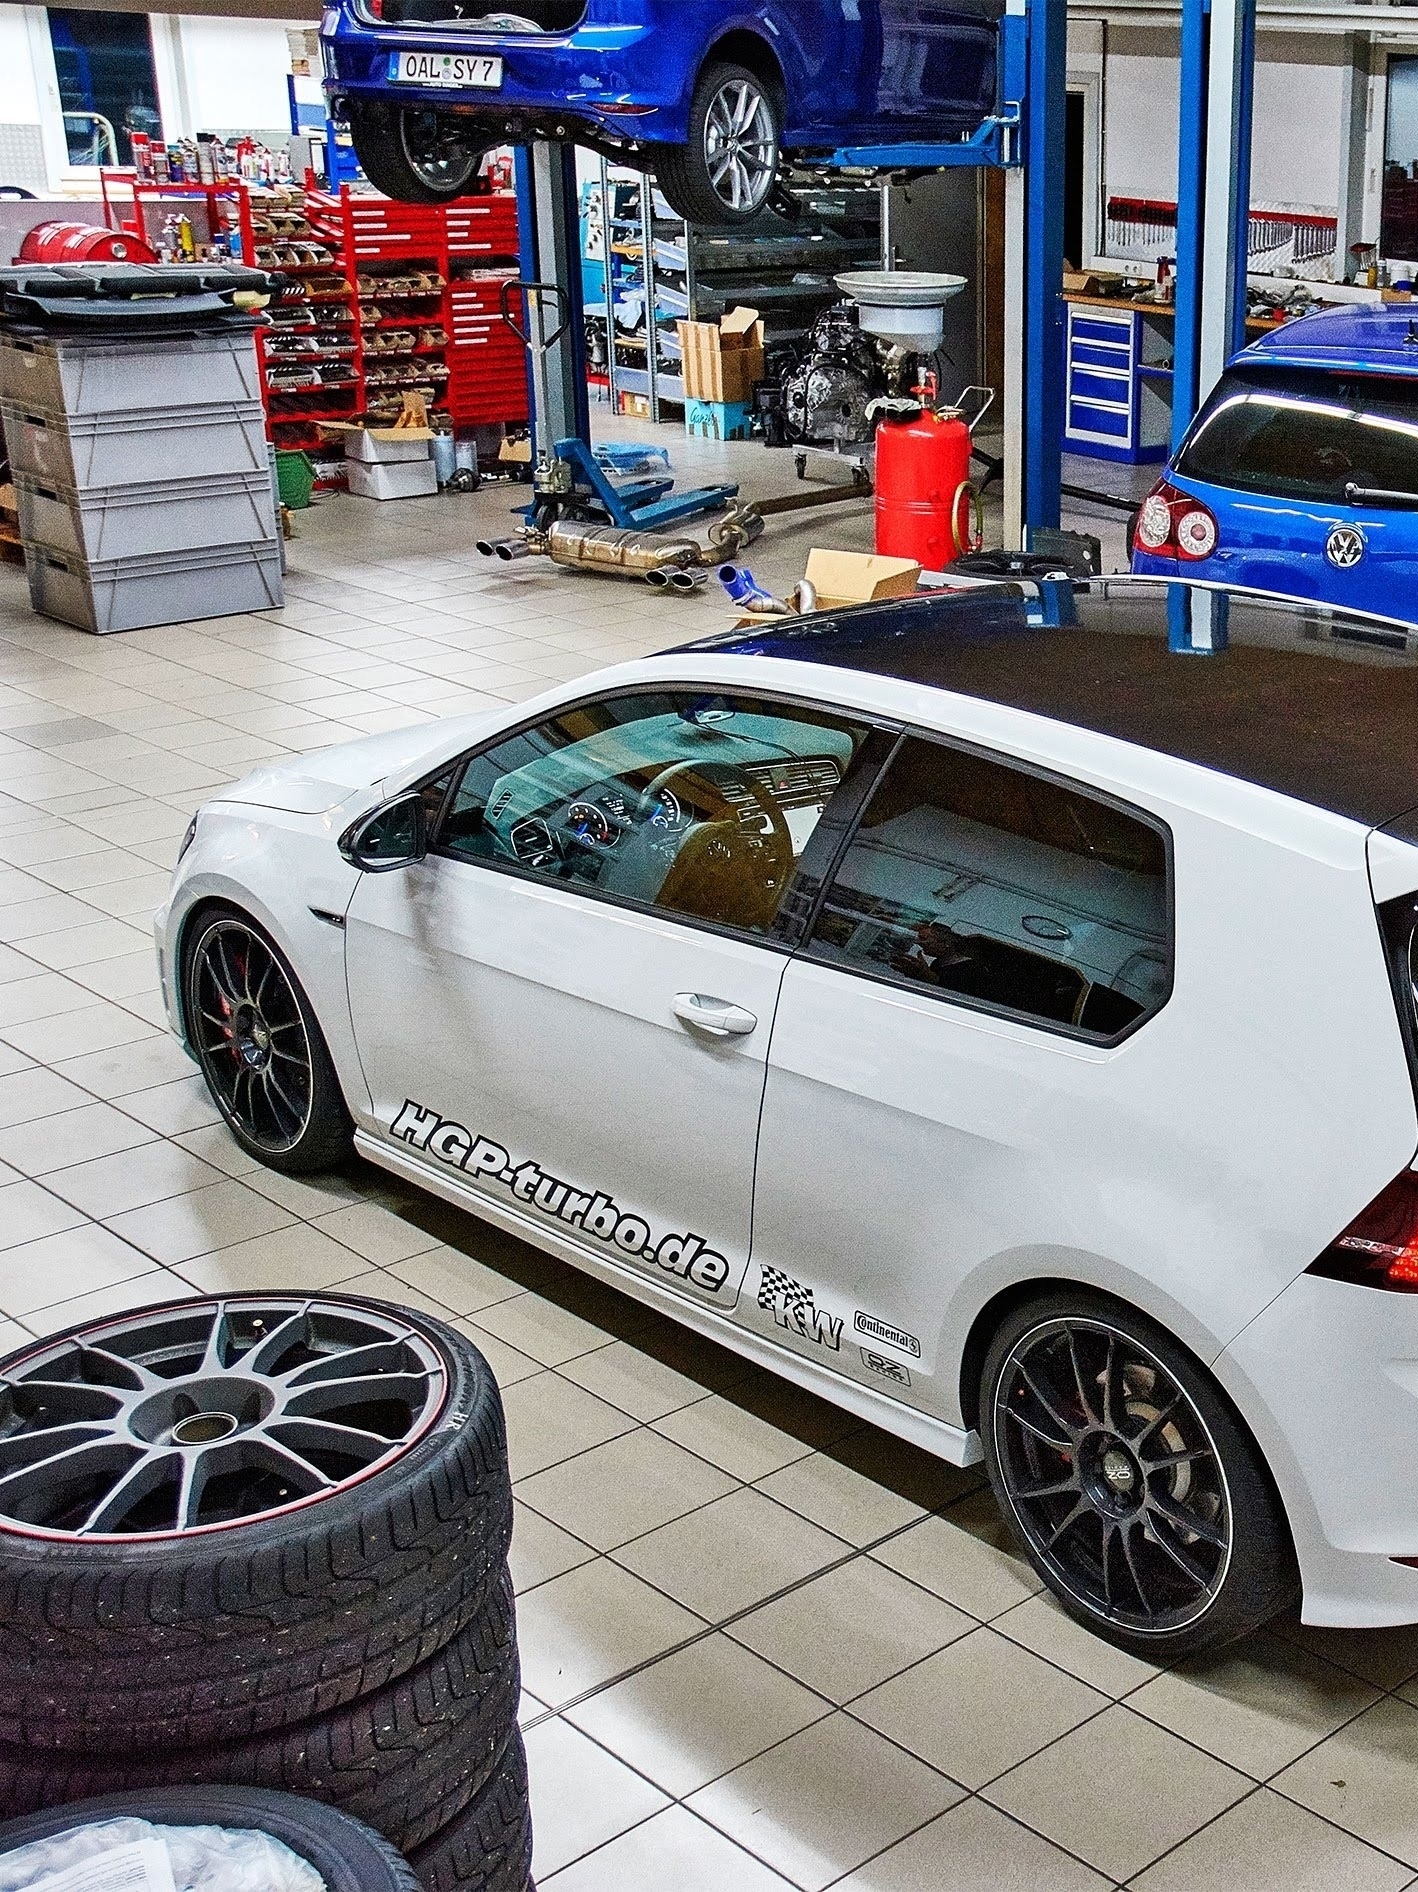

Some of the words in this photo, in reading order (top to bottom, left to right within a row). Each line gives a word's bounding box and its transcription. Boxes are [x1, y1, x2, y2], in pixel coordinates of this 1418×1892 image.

[406, 55, 440, 78] OAL
[453, 58, 477, 80] SY
[483, 60, 494, 81] 7
[389, 1099, 730, 1293] HGP-turbo.de
[773, 1292, 844, 1352] KW
[856, 1315, 908, 1347] Continental
[867, 1353, 901, 1372] OZ
